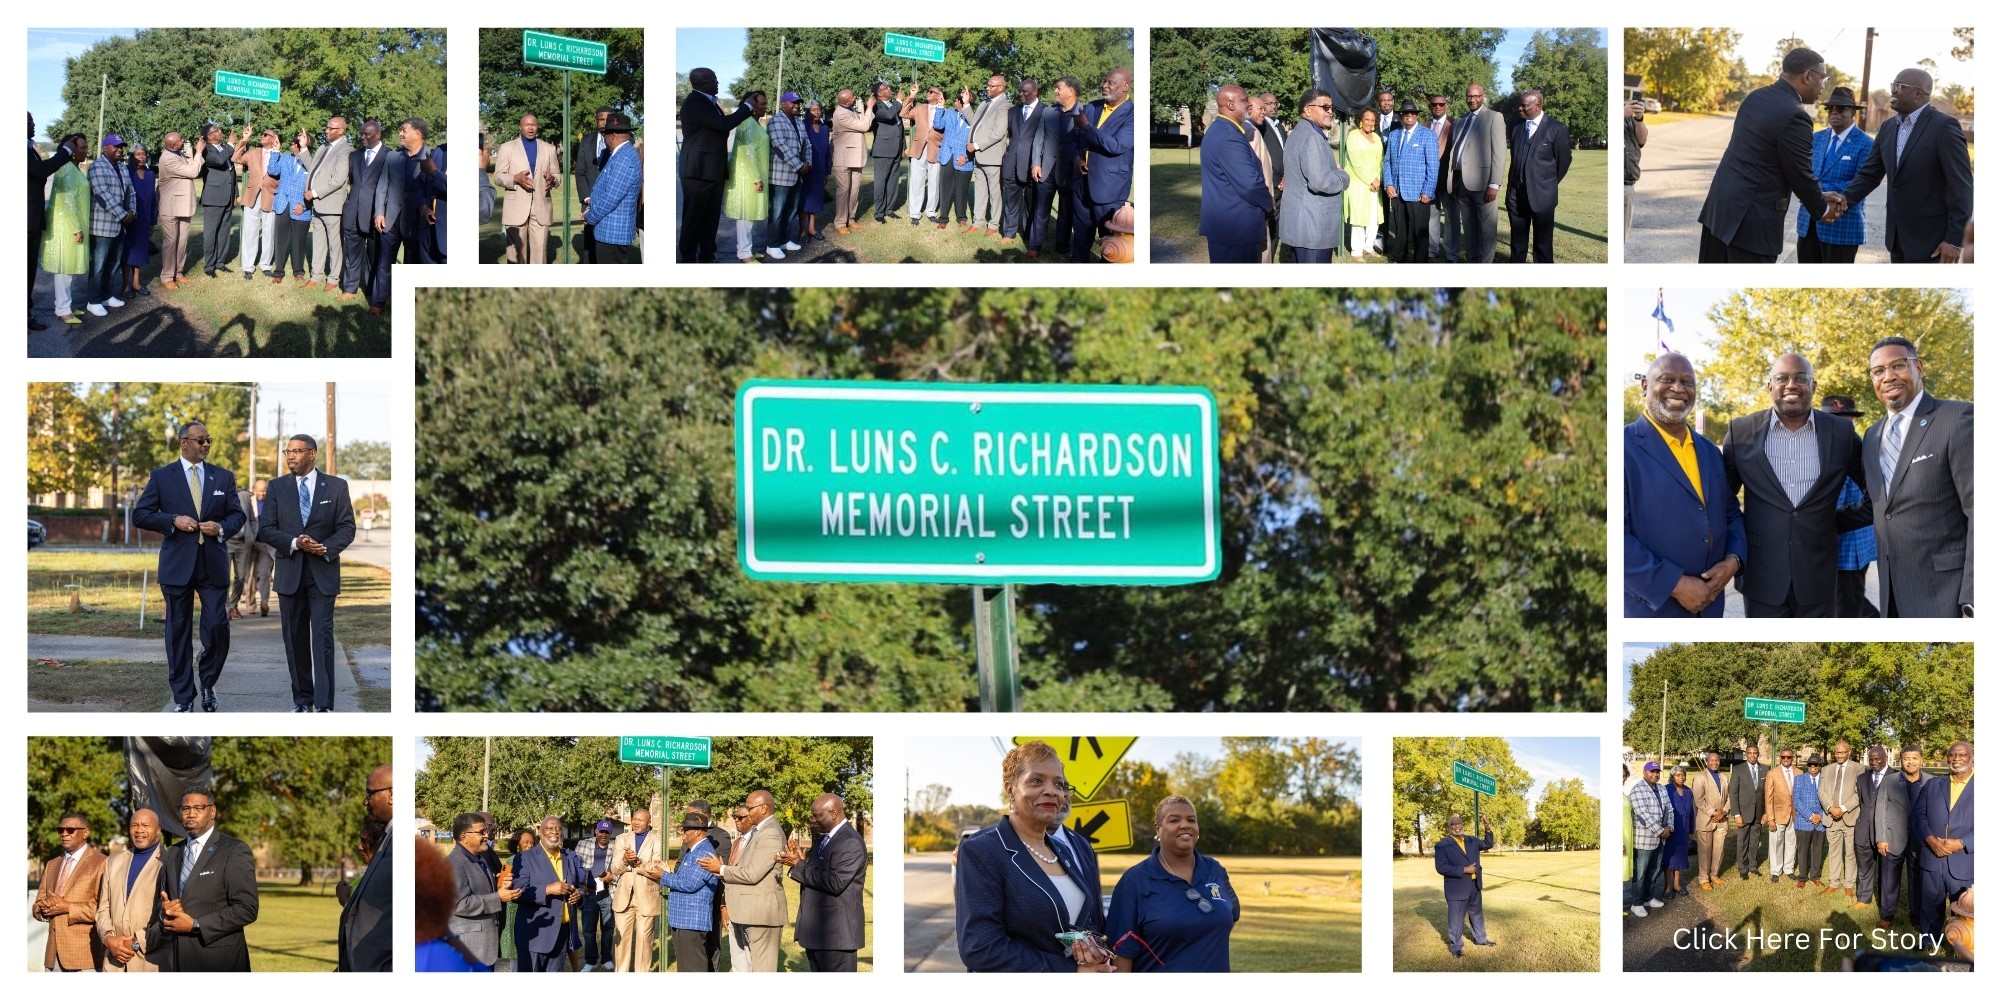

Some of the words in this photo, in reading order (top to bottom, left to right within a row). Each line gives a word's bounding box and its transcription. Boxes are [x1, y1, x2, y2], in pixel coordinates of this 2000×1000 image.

[527, 37, 538, 48] DR.
[540, 39, 557, 50] LUNS
[558, 43, 564, 52] C.
[566, 44, 604, 58] RICHARDSON
[538, 50, 570, 63] MEMORIAL
[572, 55, 594, 66] STREET
[226, 84, 251, 95] MEMORIAL
[761, 427, 814, 473] DR.
[830, 428, 917, 475] LUNS
[930, 430, 958, 476] C.
[973, 431, 1193, 478] RICHARDSON
[820, 491, 996, 539] MEMORIAL
[1010, 494, 1135, 540] STREET
[623, 736, 635, 747] DR.
[637, 738, 655, 748] LUNS
[656, 740, 662, 749] C.
[665, 740, 707, 752] RICHARDSON
[635, 748, 669, 760] MEMORIAL
[671, 751, 696, 761] STREET
